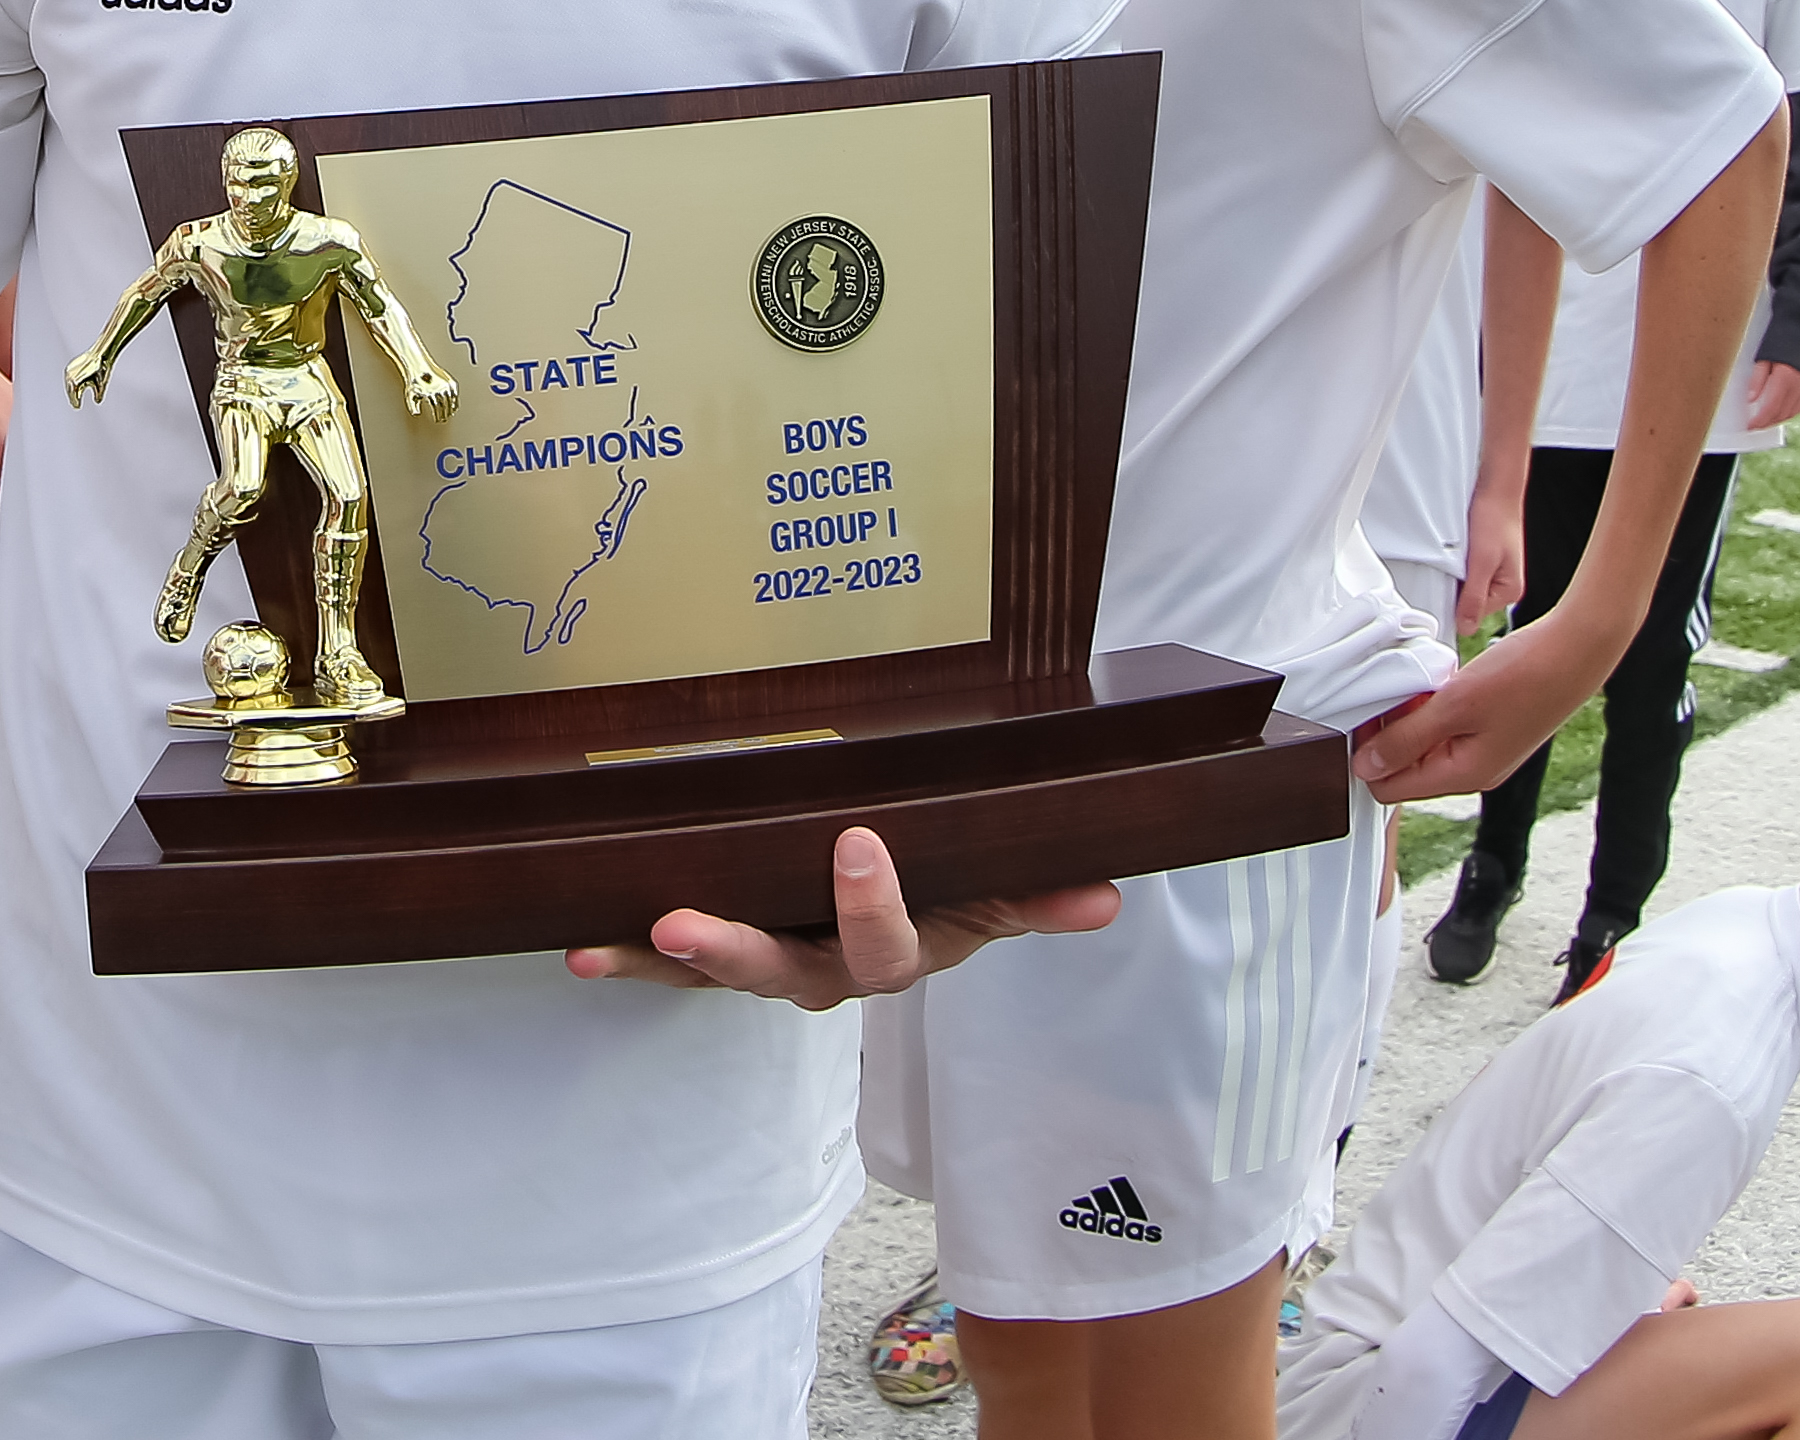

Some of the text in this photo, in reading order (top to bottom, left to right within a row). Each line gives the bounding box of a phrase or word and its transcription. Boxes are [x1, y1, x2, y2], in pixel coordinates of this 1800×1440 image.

[766, 221, 871, 262] NEW JERSEY STATE
[844, 265, 857, 298] 1918
[761, 264, 826, 343] INTERSCHOLASTIC
[829, 303, 875, 342] ATHLETIC
[490, 353, 618, 395] STATE
[436, 425, 684, 479] CHAMPIONS
[783, 415, 868, 454] BOYS
[766, 460, 893, 505] SOCCER
[770, 507, 898, 552] GROUP I
[753, 553, 922, 603] 2022-2023
[1059, 1208, 1163, 1243] adidas
